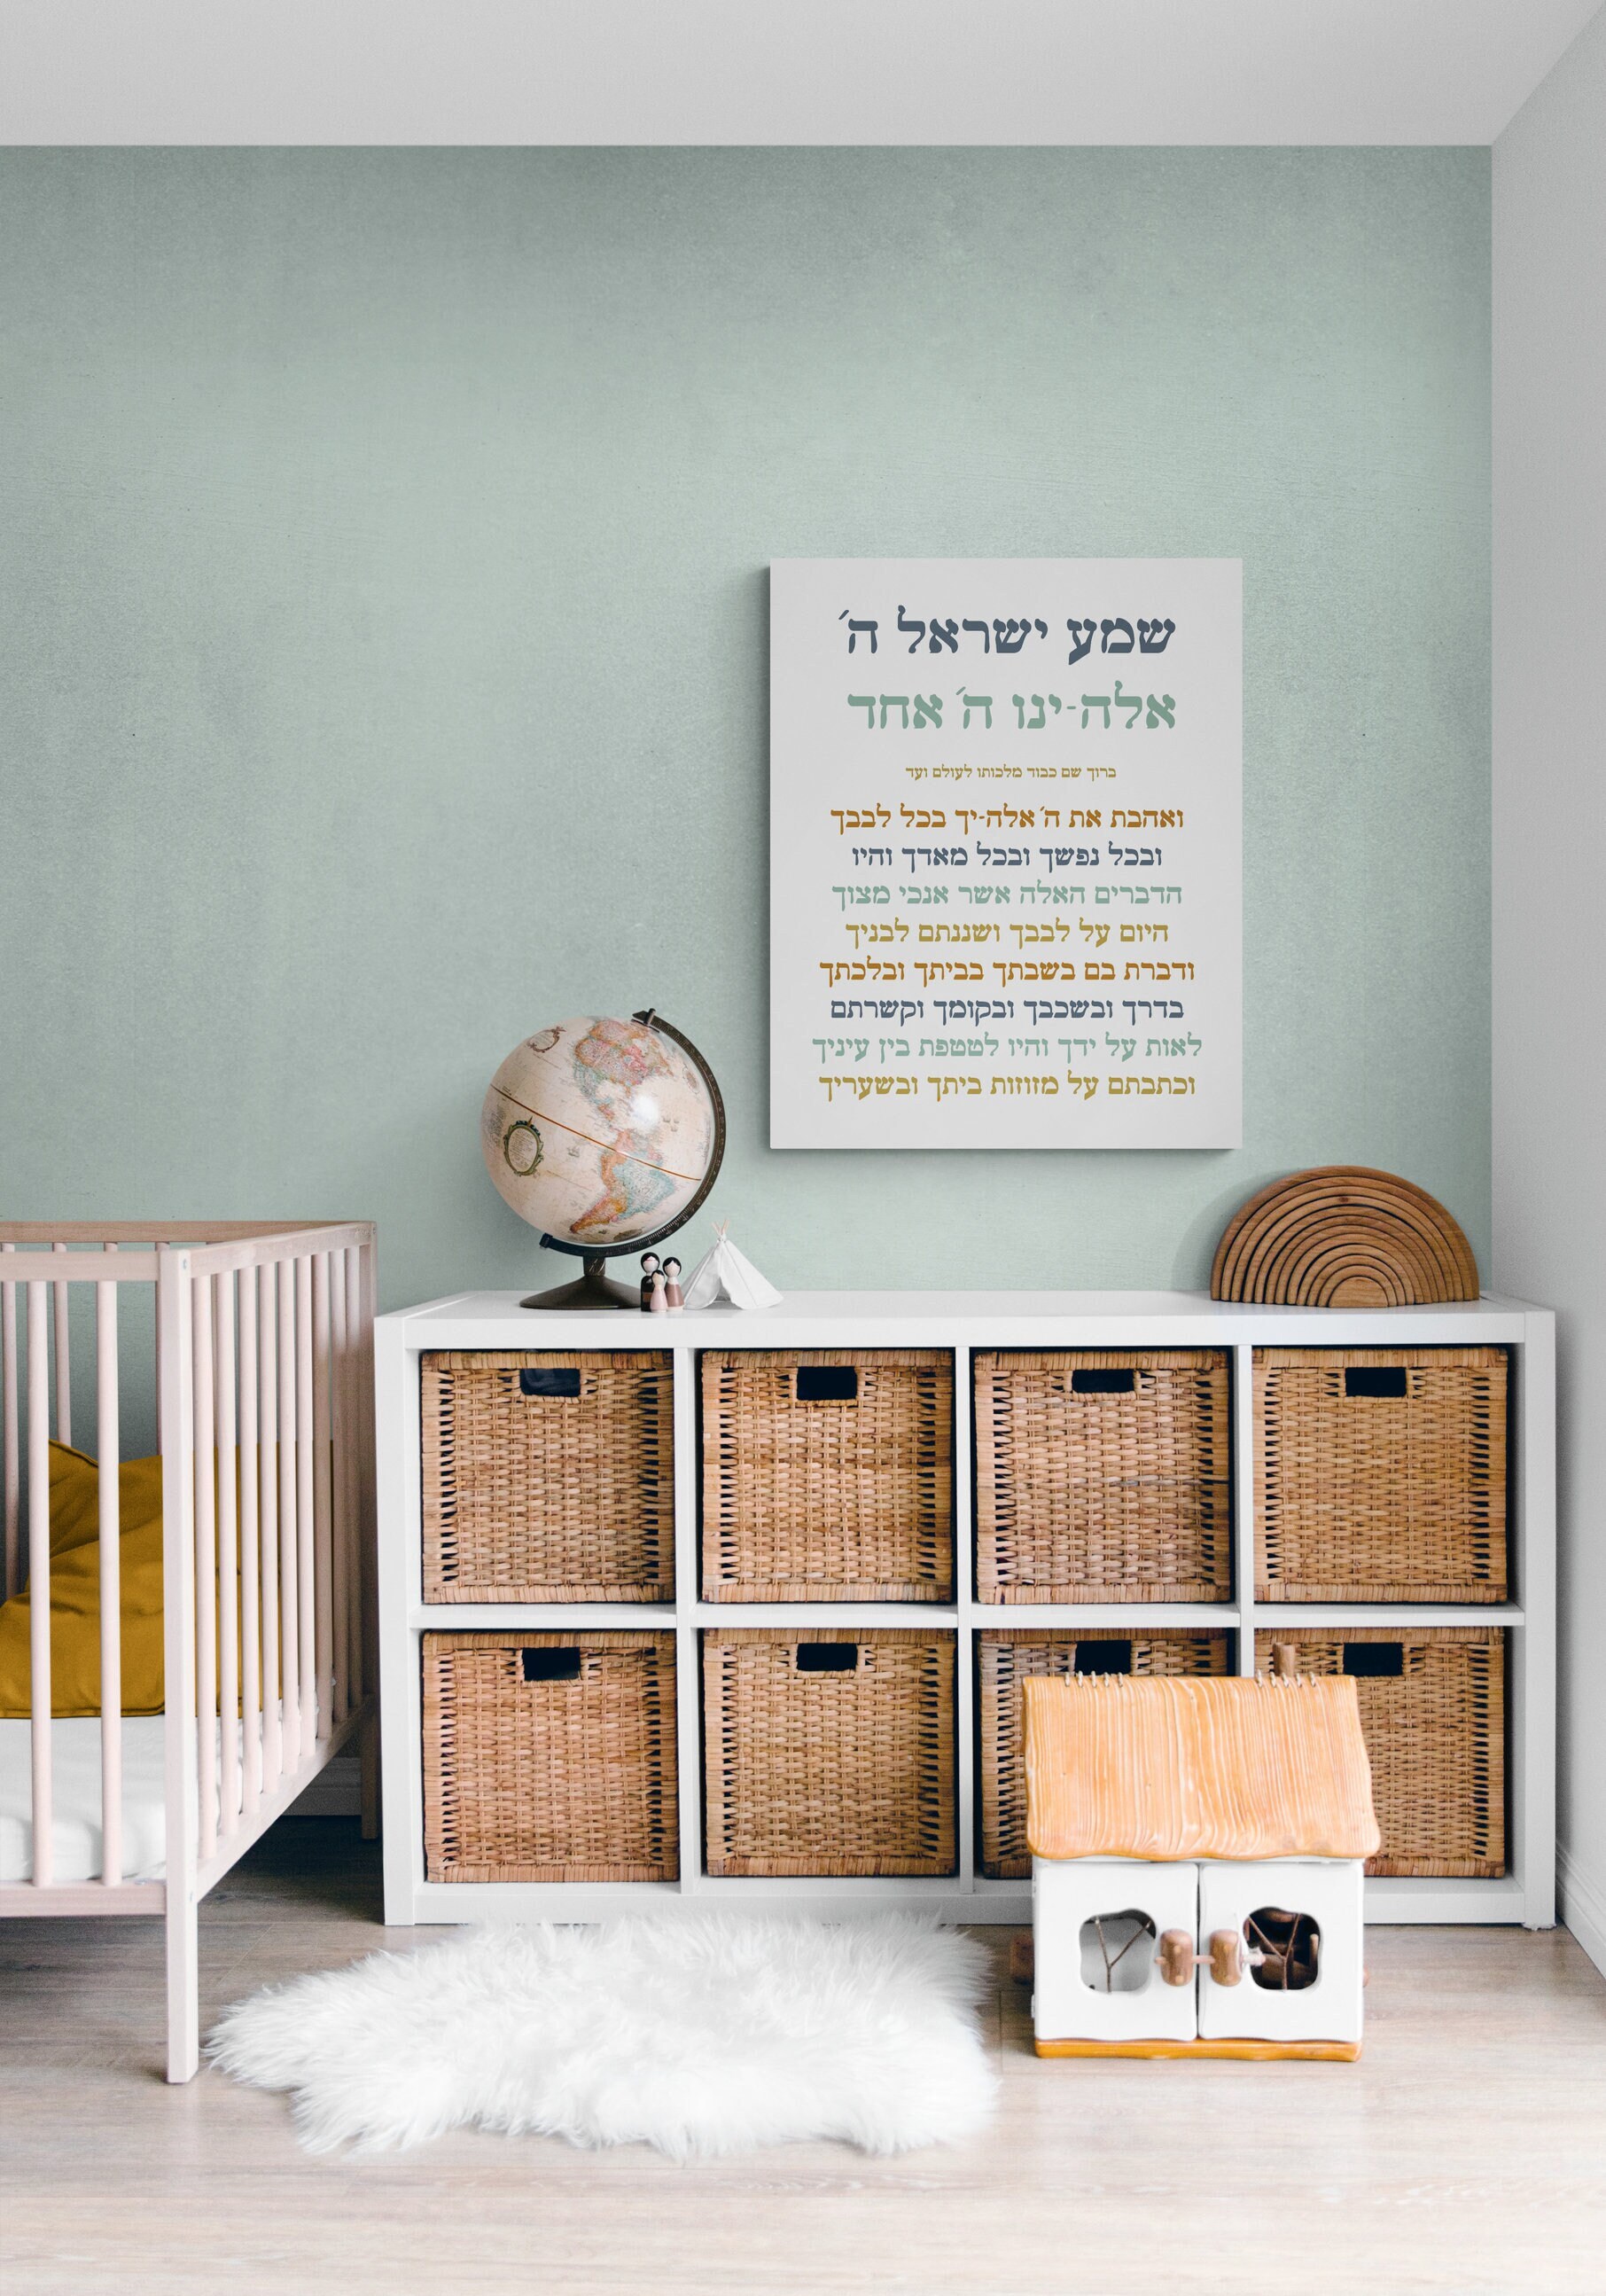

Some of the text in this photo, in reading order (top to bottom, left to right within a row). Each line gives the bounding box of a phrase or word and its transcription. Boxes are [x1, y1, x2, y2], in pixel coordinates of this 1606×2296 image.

[897, 604, 1049, 654] ישראל
[1065, 617, 1177, 666] שמע
[846, 693, 944, 730] אחד
[1011, 679, 1176, 730] אלה-ינו
[905, 762, 1117, 783] ברוך שם כבוד מלכותו לעולם ועד
[830, 801, 893, 836] לבבך
[899, 801, 947, 829] בכל
[954, 801, 1036, 836] אלה-יך
[1067, 808, 1103, 829] את
[1110, 808, 1184, 829] ואהבת
[851, 840, 1163, 874] ובכל נפשך ובכל מאדך והיו
[831, 879, 1182, 912] הדברים האלה אשר אנכי מצוך
[845, 916, 1169, 950] היום על לבבך ושננתם לבניך
[818, 954, 1196, 988] ודברת בם בשבתך בביתך ובלכתך
[830, 999, 1185, 1027] בדרך ובשכבך ובקומך וקשרתם
[812, 1030, 1203, 1065] לאות על ידך והיו לטטפת בין עיניך
[818, 1068, 1196, 1103] וכתבתם על מזוזות ביתך ובשעריך
